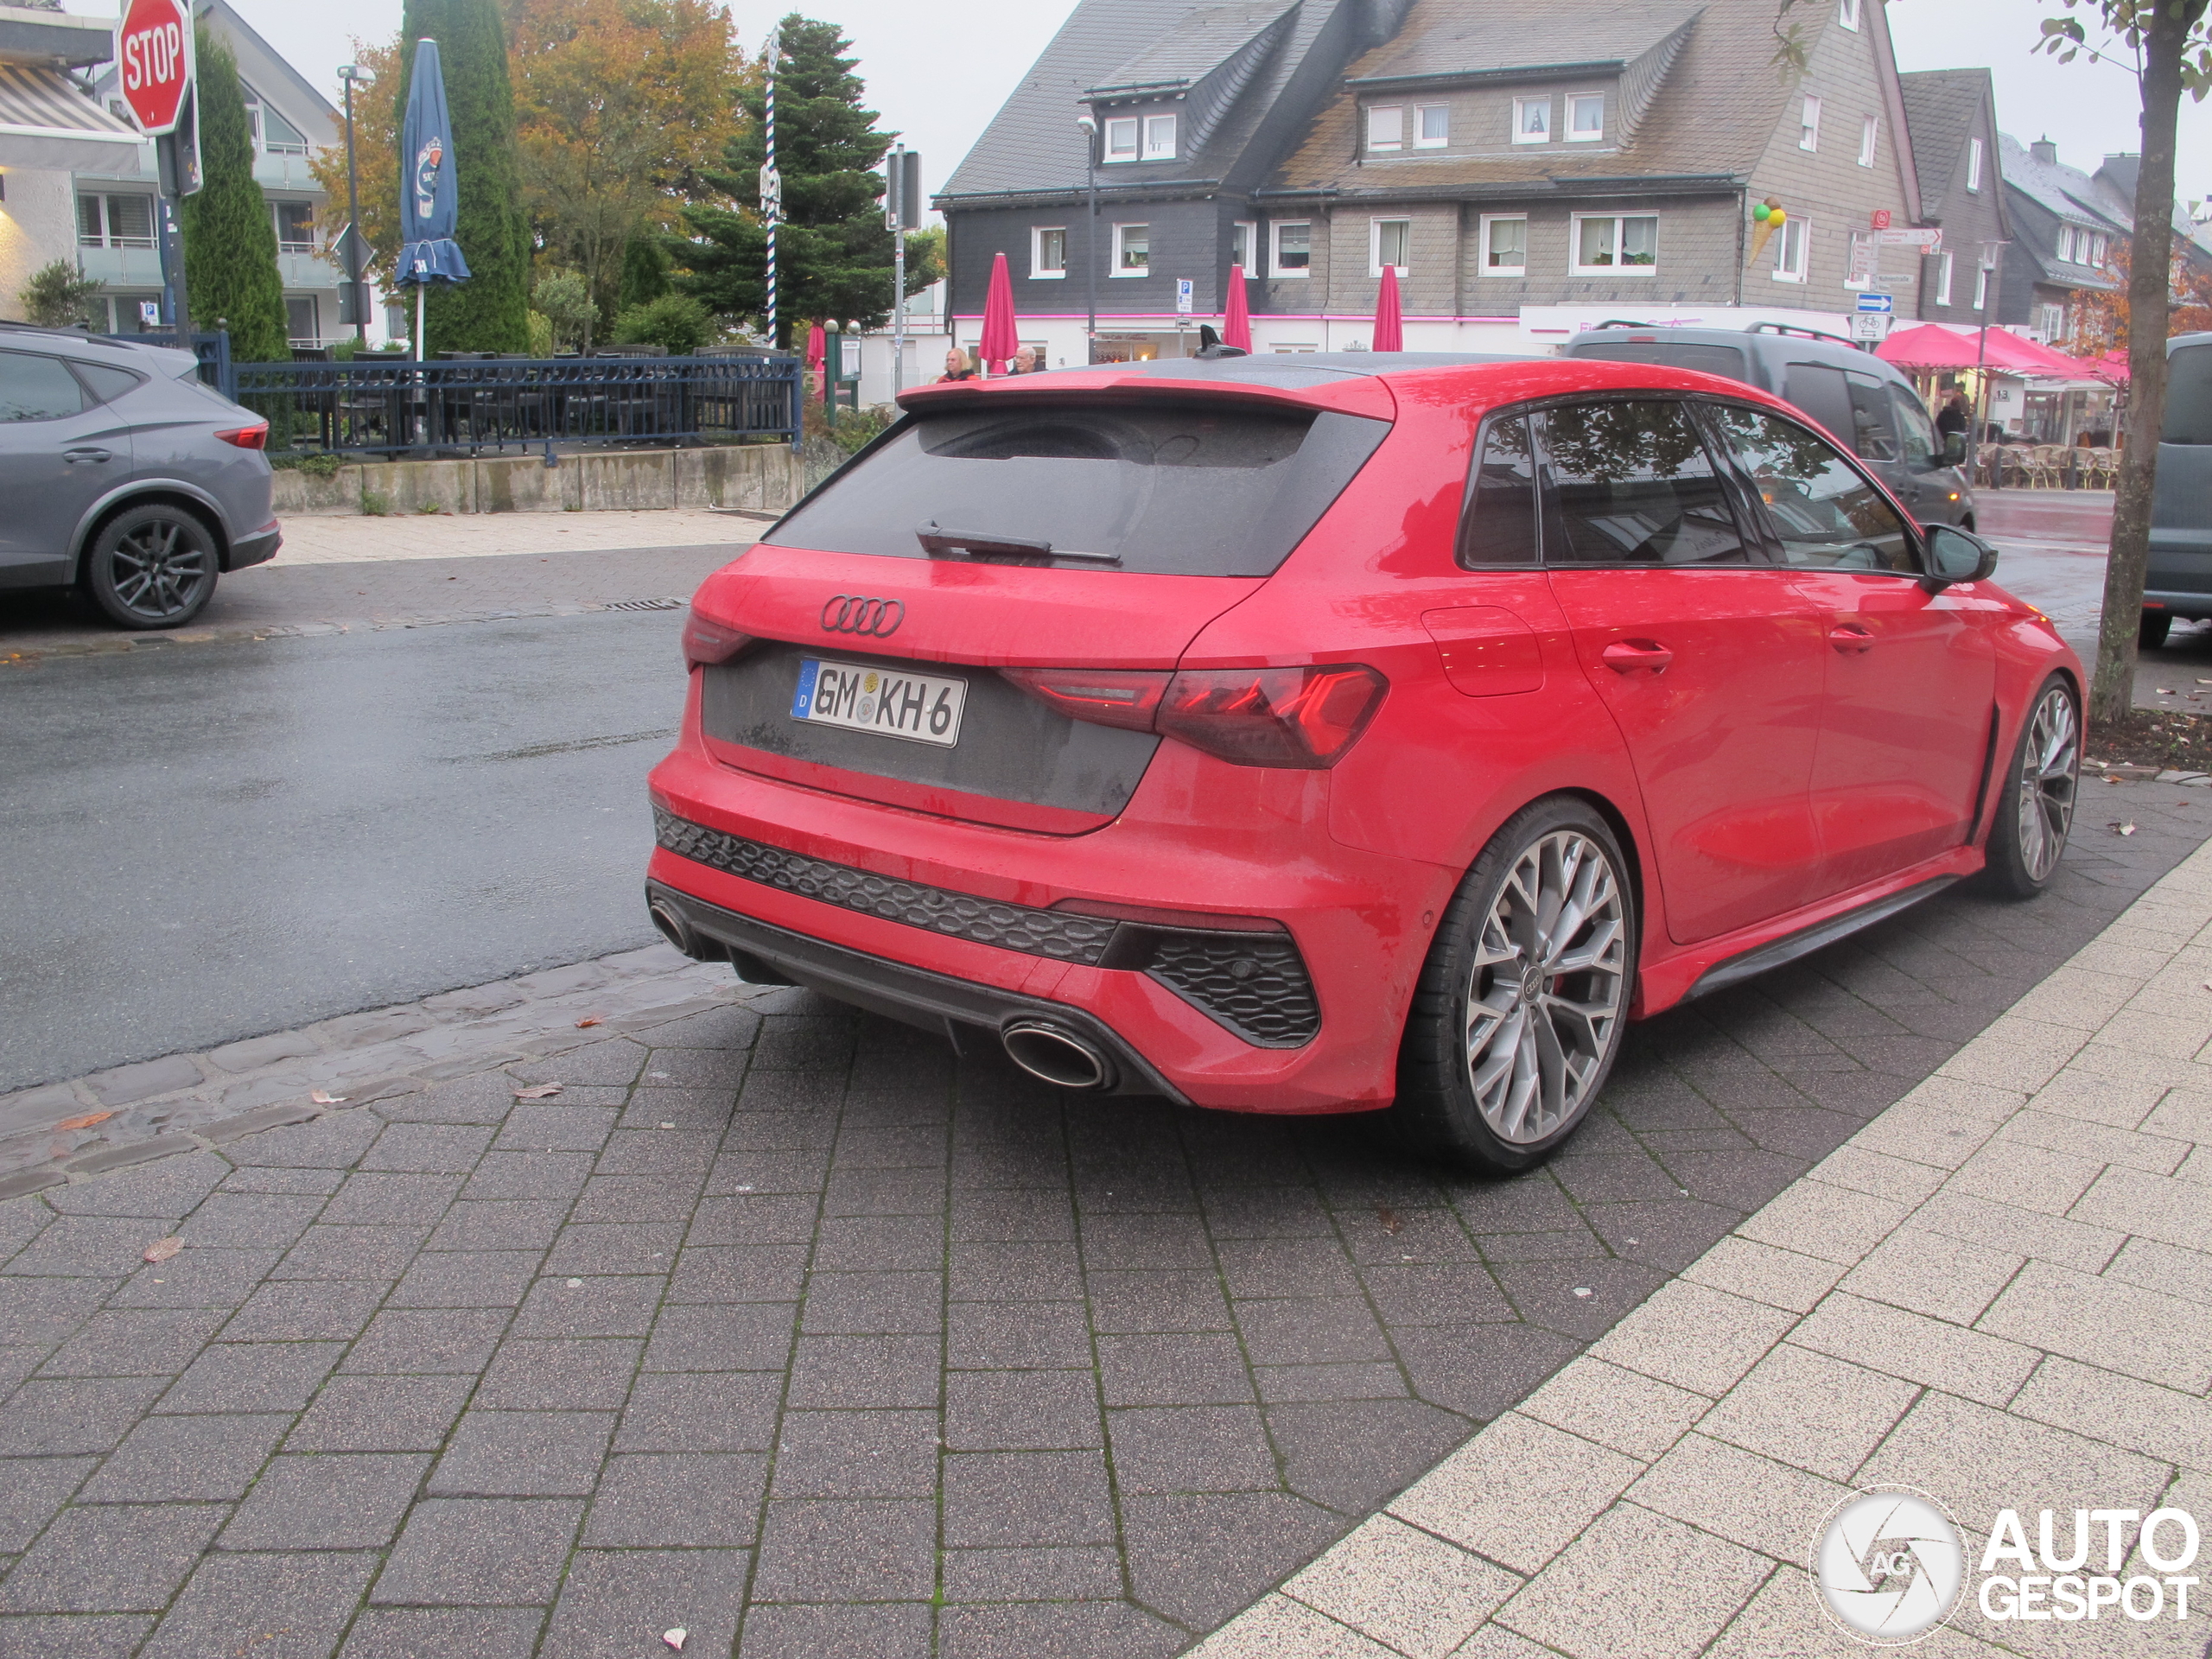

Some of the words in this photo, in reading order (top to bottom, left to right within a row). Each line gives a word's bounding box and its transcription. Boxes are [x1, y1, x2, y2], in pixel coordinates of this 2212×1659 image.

[125, 22, 180, 91] STOP
[1182, 283, 1189, 293] P
[147, 306, 153, 315] P
[1996, 390, 2008, 399] 13
[799, 695, 807, 708] D
[815, 669, 860, 719] GM
[875, 678, 926, 731] KH
[929, 687, 951, 735] 6
